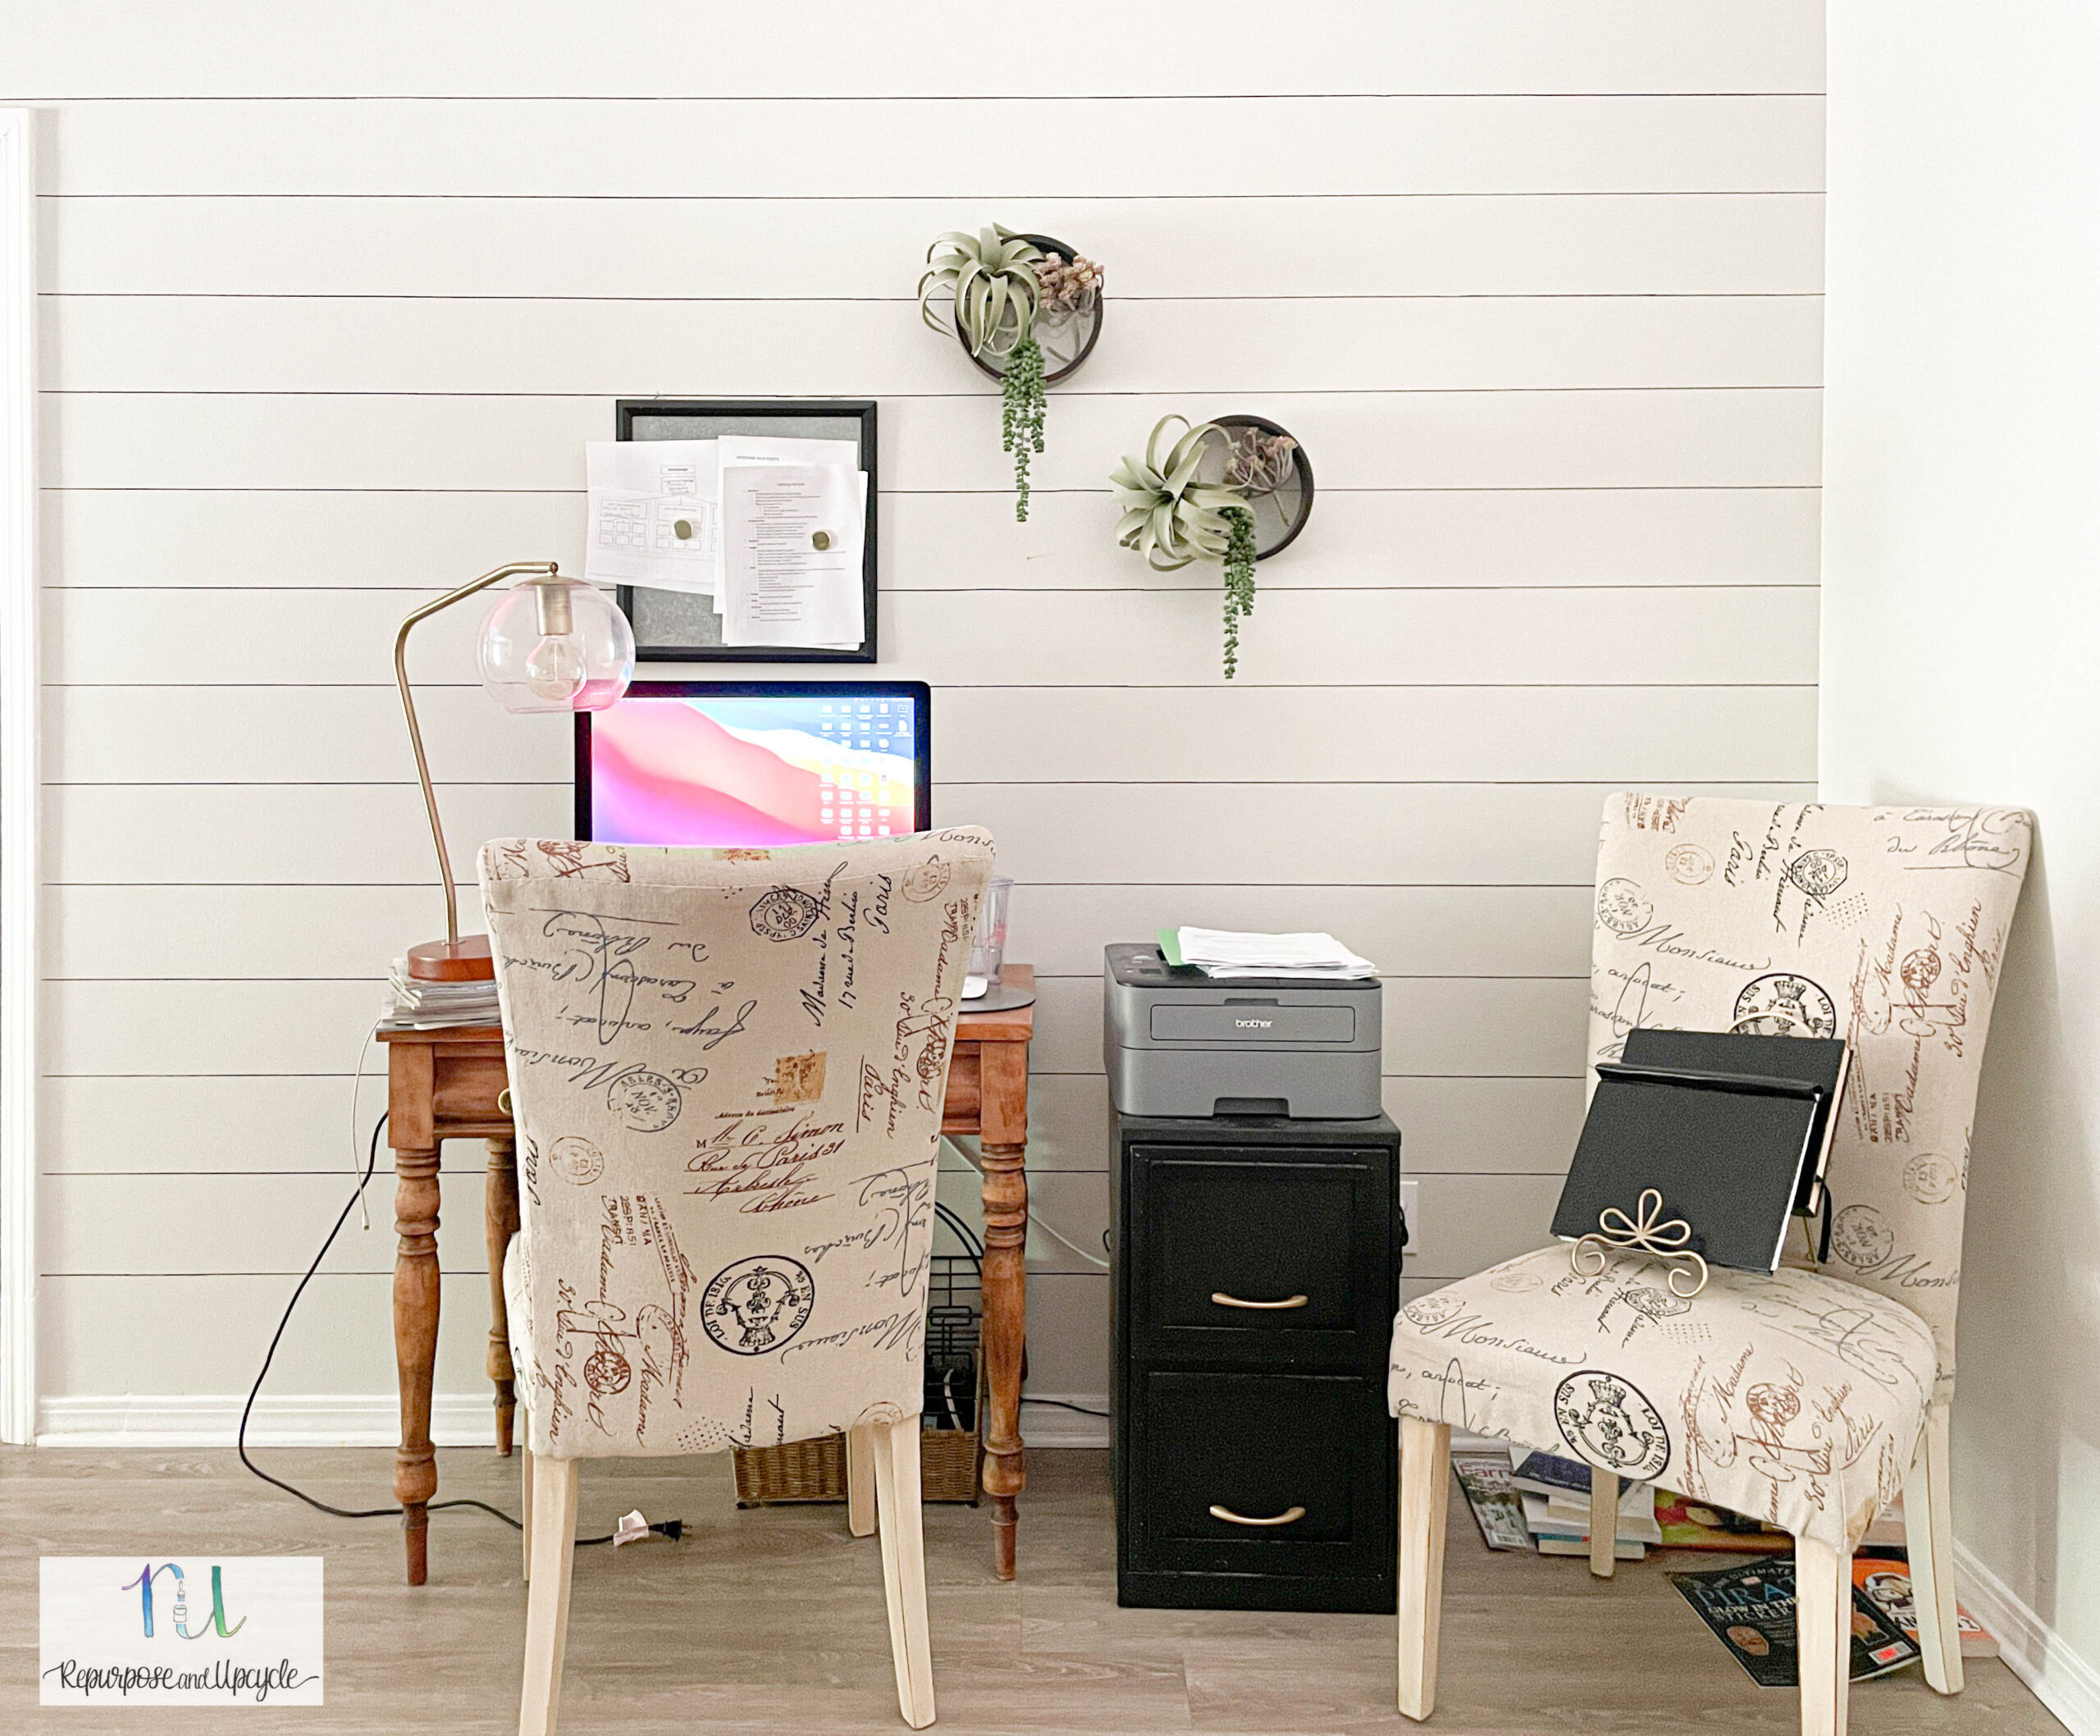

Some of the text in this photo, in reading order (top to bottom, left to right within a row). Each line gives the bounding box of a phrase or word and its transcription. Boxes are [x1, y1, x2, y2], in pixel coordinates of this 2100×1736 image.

[1235, 1018, 1273, 1029] brother
[707, 1320, 725, 1339] LOI
[1641, 1407, 1662, 1430] LOI
[1695, 1575, 1796, 1609] PIRAT
